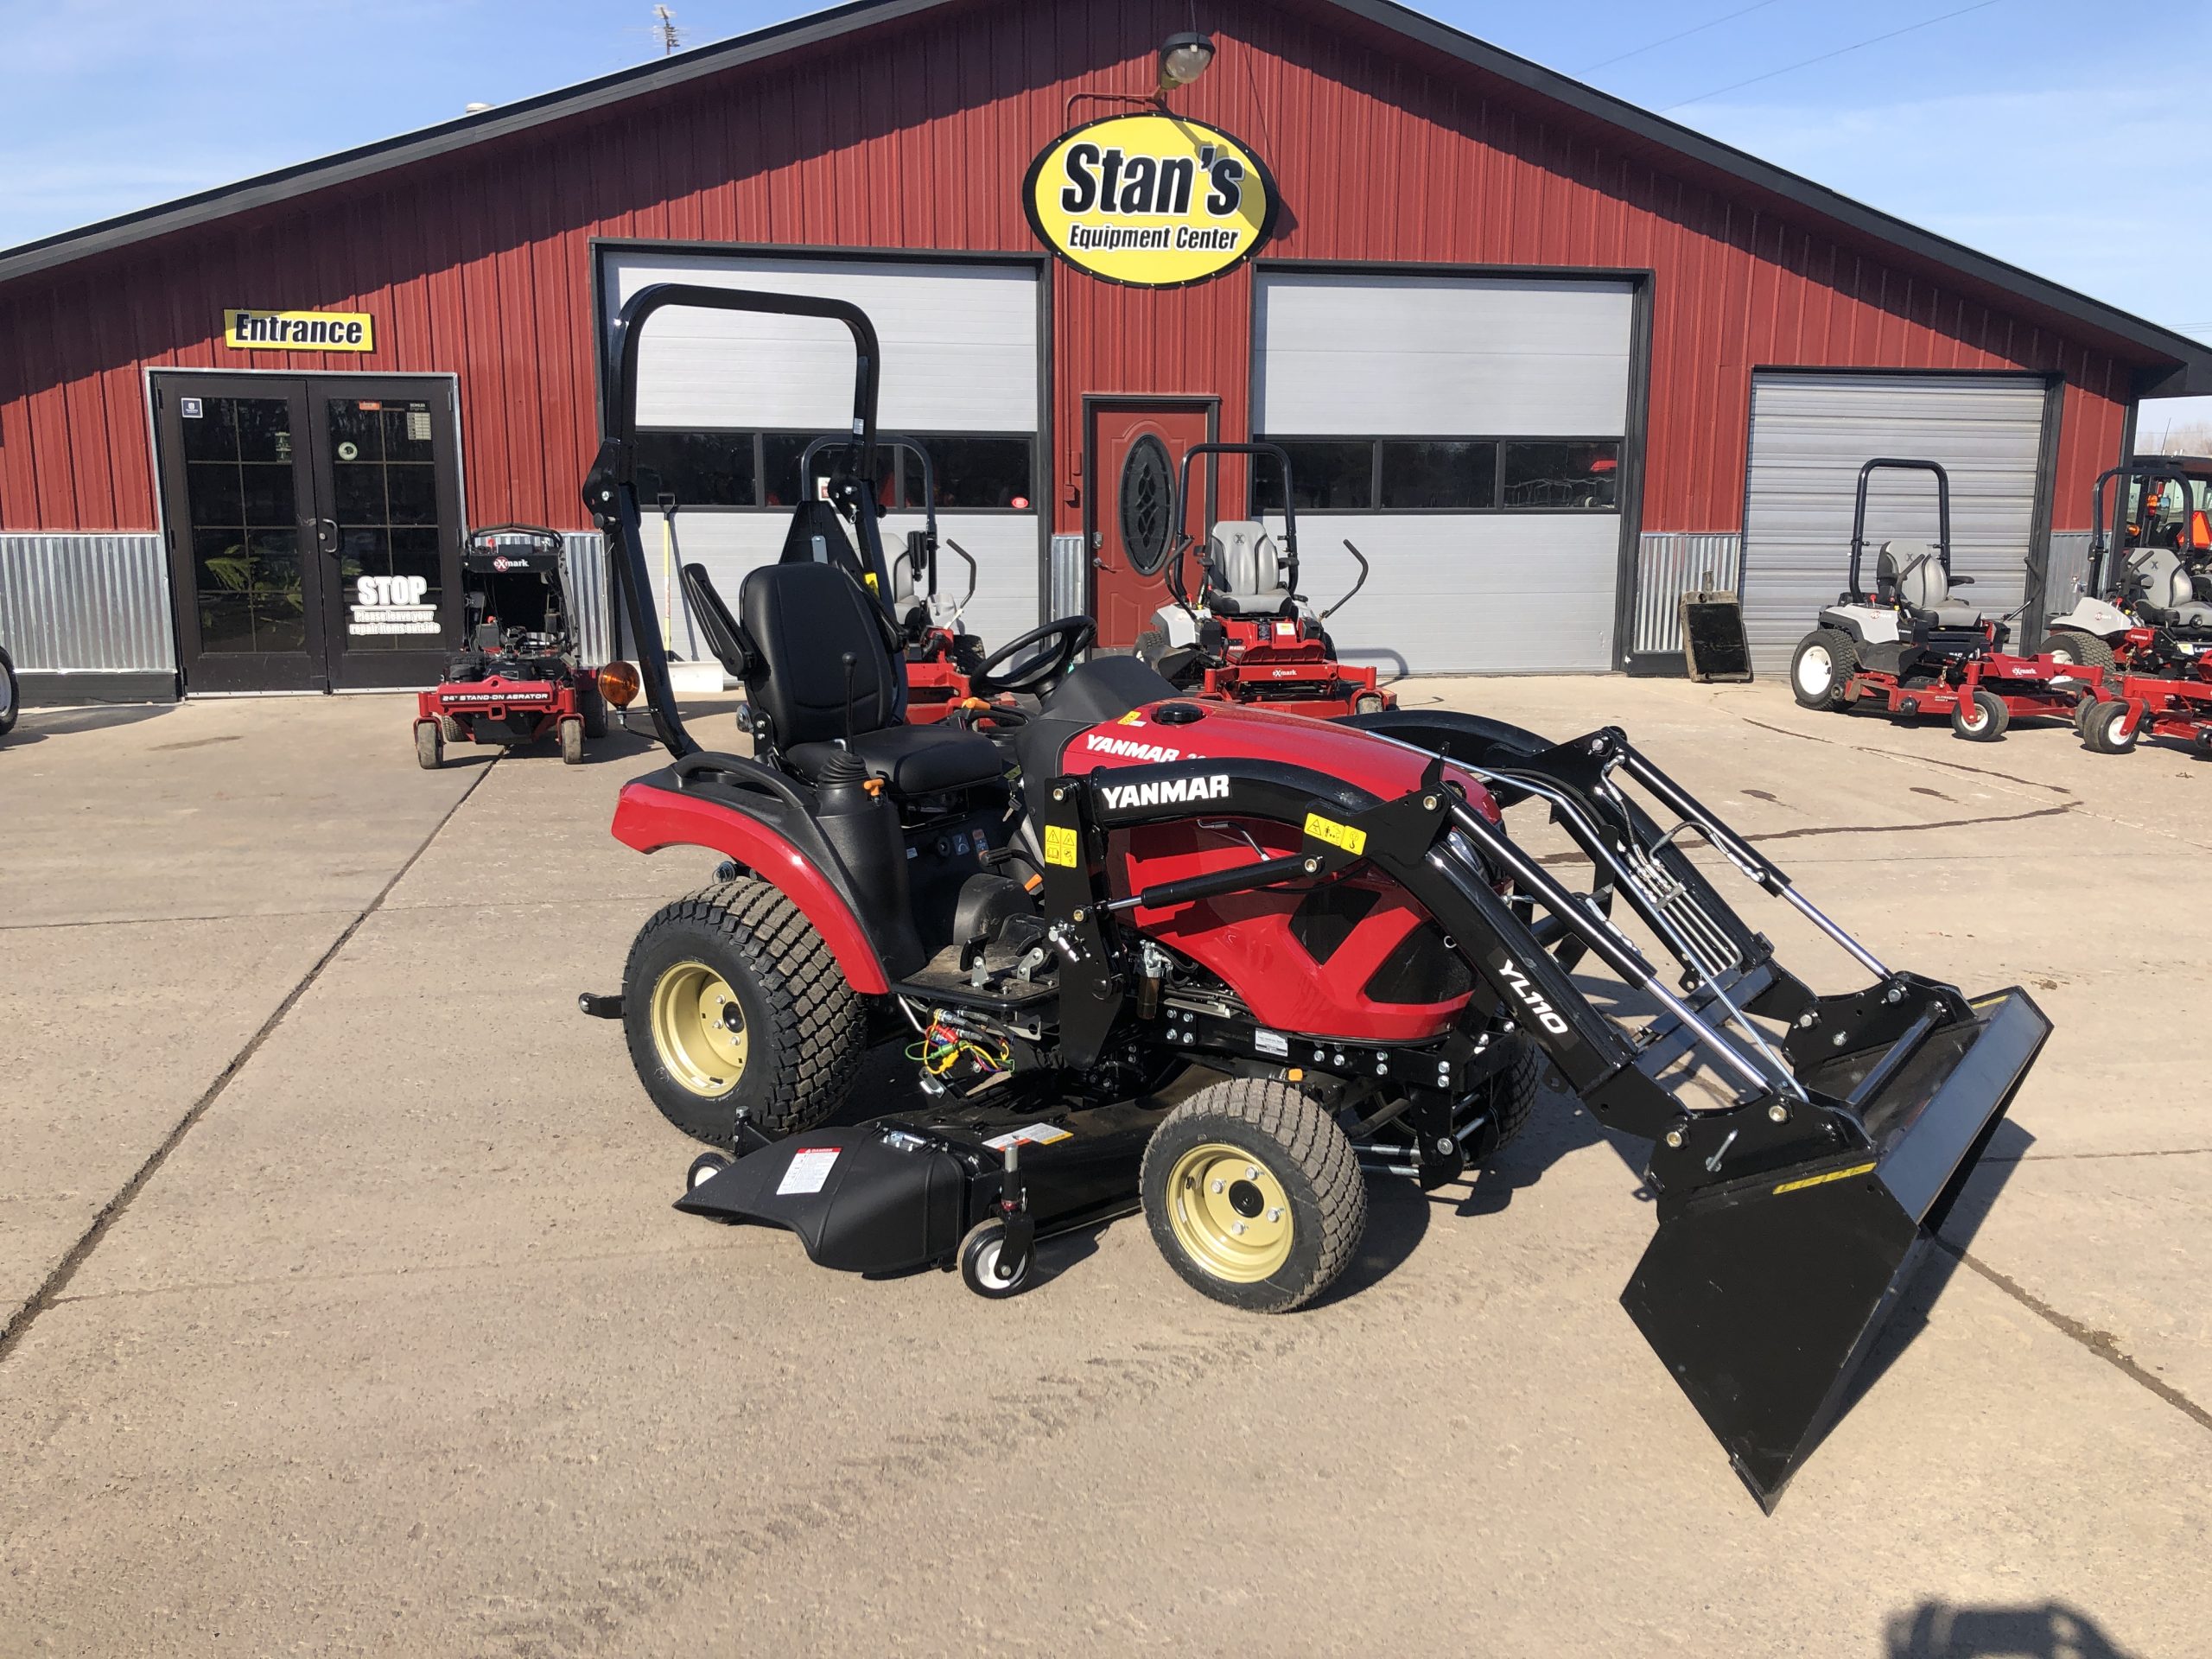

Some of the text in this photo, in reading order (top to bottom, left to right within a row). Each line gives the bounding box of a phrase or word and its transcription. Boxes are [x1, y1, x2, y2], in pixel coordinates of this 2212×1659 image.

[1062, 143, 1243, 216] Stan's
[1070, 225, 1238, 250] Equipment Center
[236, 314, 362, 344] Entrance
[493, 557, 530, 570] eXmark
[358, 575, 427, 605] STOP
[350, 622, 440, 635] repair items outside
[355, 610, 434, 622] Please leave your
[1086, 734, 1180, 762] YANMAR
[1102, 774, 1229, 809] YANMAR
[1498, 958, 1568, 1033] YL110
